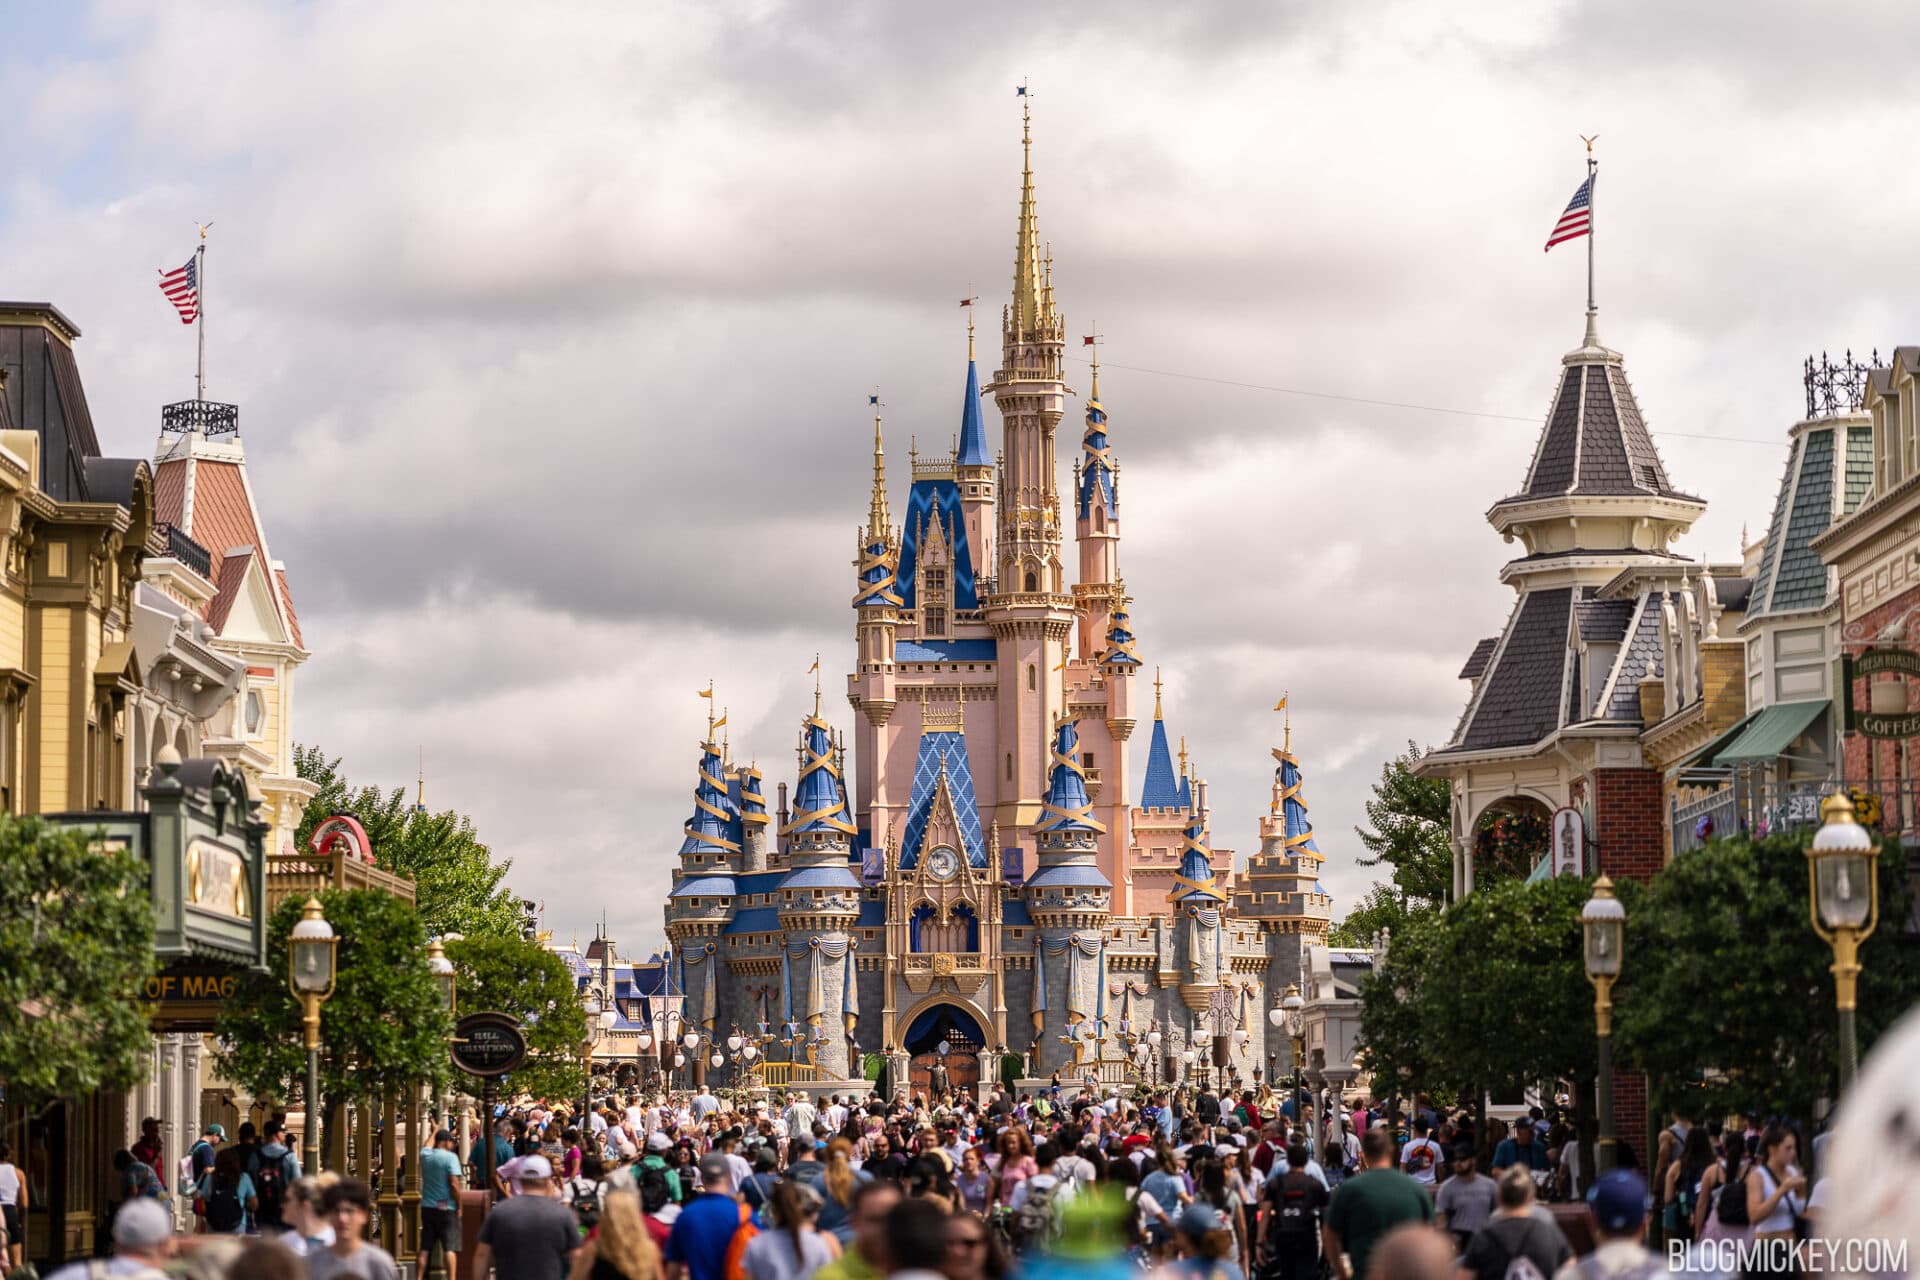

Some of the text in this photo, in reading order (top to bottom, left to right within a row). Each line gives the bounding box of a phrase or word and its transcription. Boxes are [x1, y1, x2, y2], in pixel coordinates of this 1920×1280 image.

[1859, 655, 1884, 673] FRESH
[1863, 717, 1920, 735] COFFEE
[145, 976, 176, 998] OF
[183, 976, 238, 998] MAG
